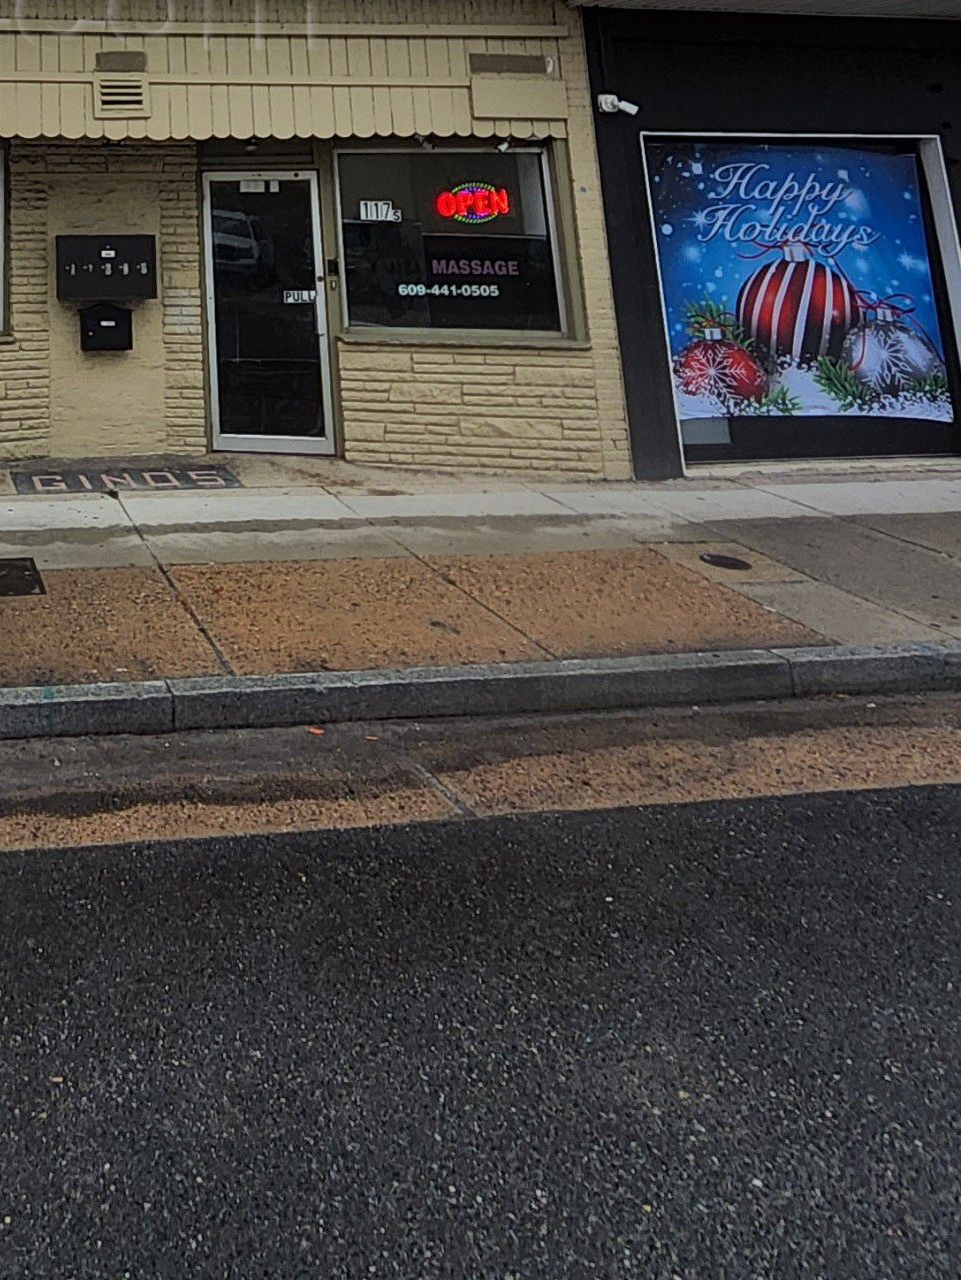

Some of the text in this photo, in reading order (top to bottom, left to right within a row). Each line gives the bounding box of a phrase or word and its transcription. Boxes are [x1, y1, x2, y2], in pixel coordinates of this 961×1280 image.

[709, 162, 854, 215] Happy
[437, 188, 509, 217] OPEN
[698, 204, 881, 257] Holidays
[432, 260, 519, 275] MASSAGE
[285, 291, 317, 302] PULL
[398, 284, 500, 297] 609-441-0505
